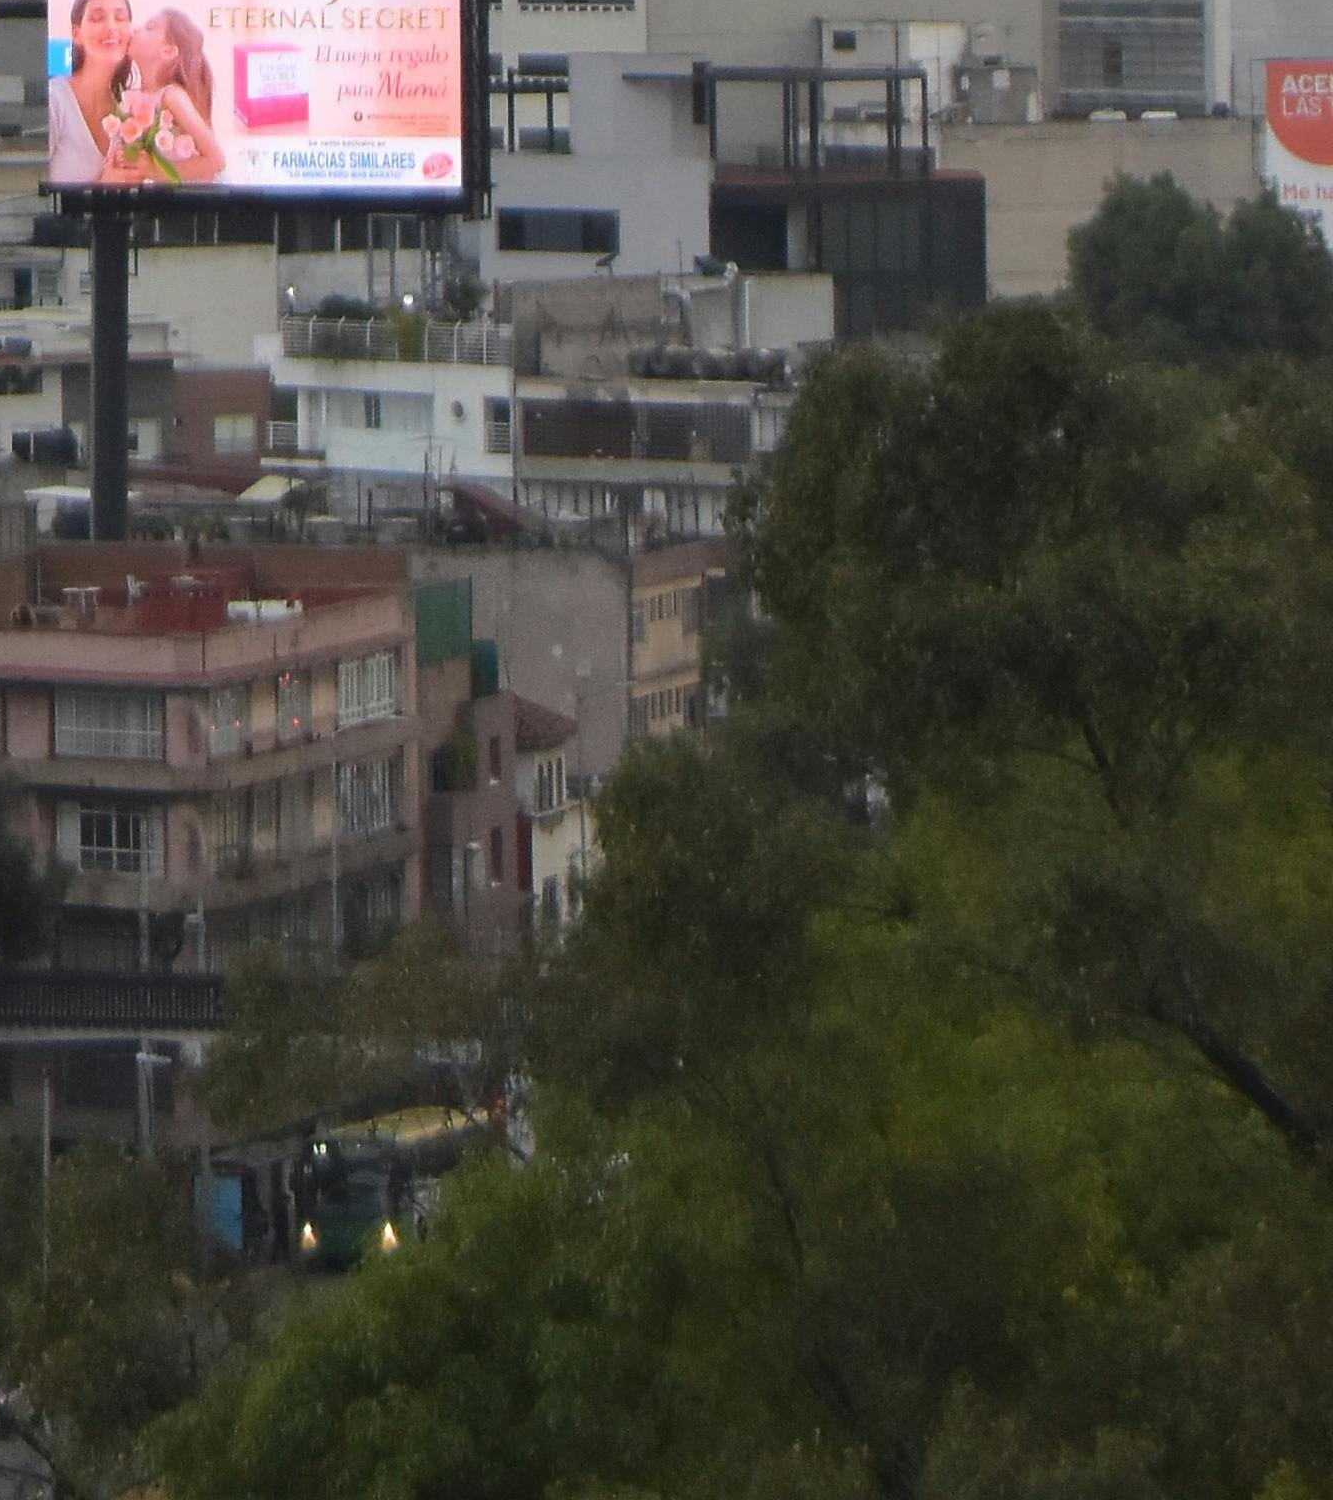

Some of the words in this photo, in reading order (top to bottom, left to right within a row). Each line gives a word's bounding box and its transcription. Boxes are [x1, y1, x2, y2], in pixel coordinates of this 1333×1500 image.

[209, 8, 333, 29] ETERNAL
[341, 8, 450, 29] SECRET
[315, 45, 332, 63] El
[334, 46, 382, 67] mejor
[386, 43, 449, 68] regalo
[337, 83, 374, 102] para
[376, 70, 450, 100] Mamá
[1282, 74, 1333, 92] ACE
[1283, 96, 1322, 116] LAS
[273, 152, 346, 169] FARMACIAS
[349, 152, 416, 169] SIMILARES
[1284, 182, 1310, 200] Me
